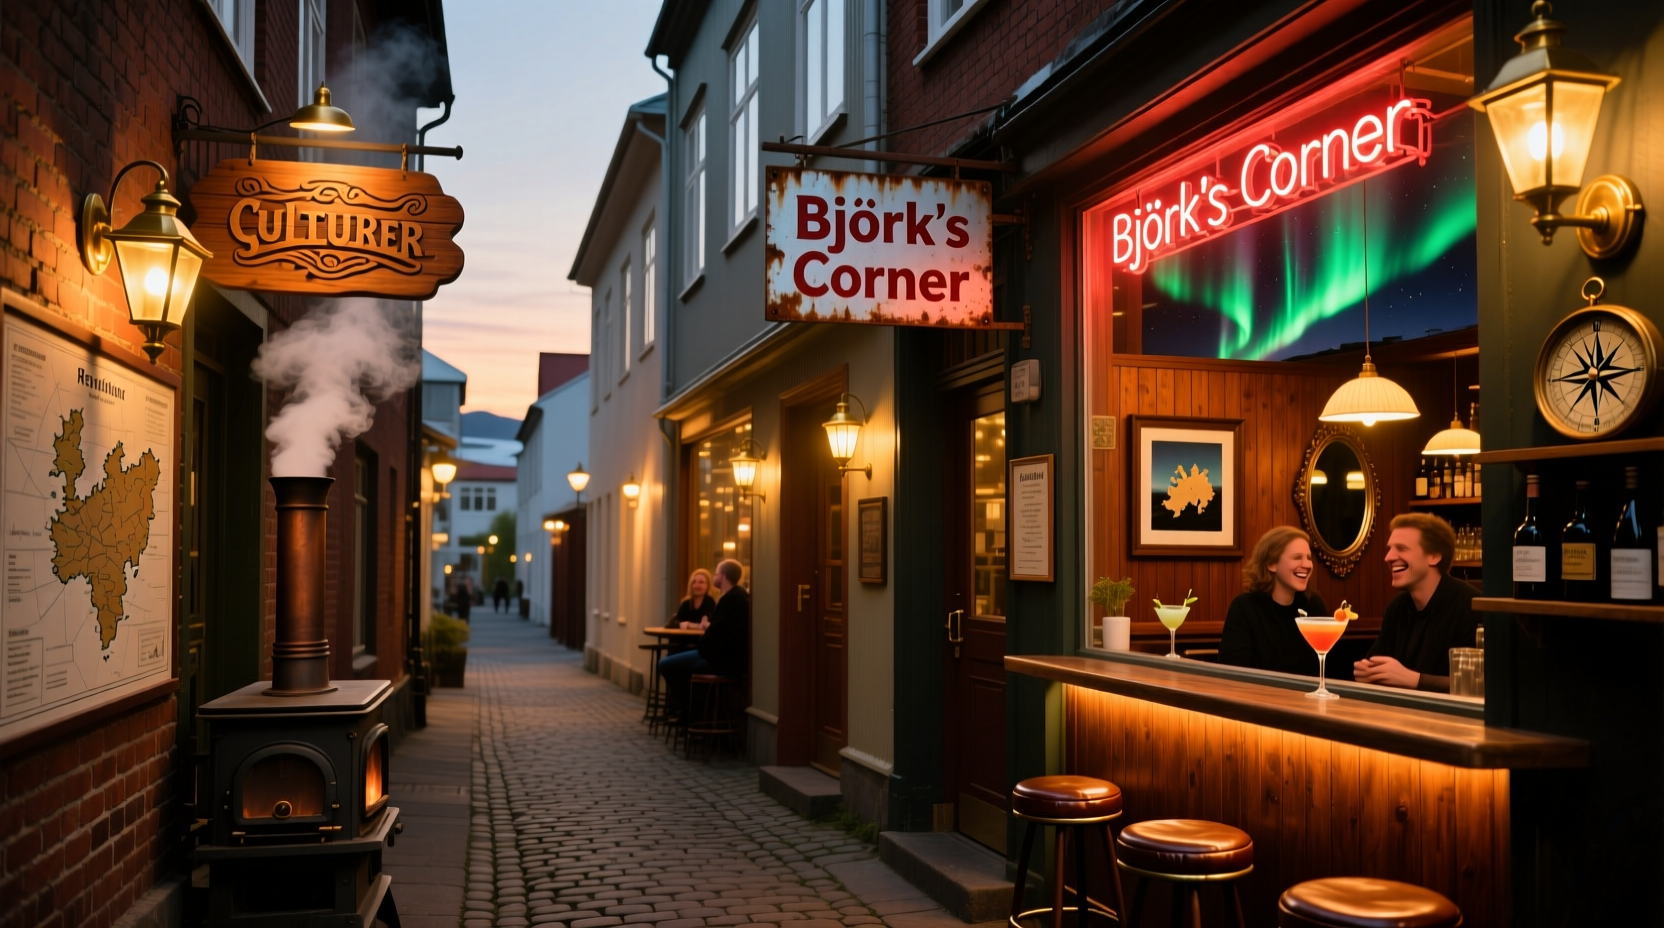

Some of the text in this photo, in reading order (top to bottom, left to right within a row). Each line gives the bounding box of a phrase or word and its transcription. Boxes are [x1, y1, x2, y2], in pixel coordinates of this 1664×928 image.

[1112, 99, 1412, 272] Björk's Corner
[229, 197, 426, 258] CULTURER
[796, 194, 970, 255] Björk's
[793, 250, 970, 302] Corner
